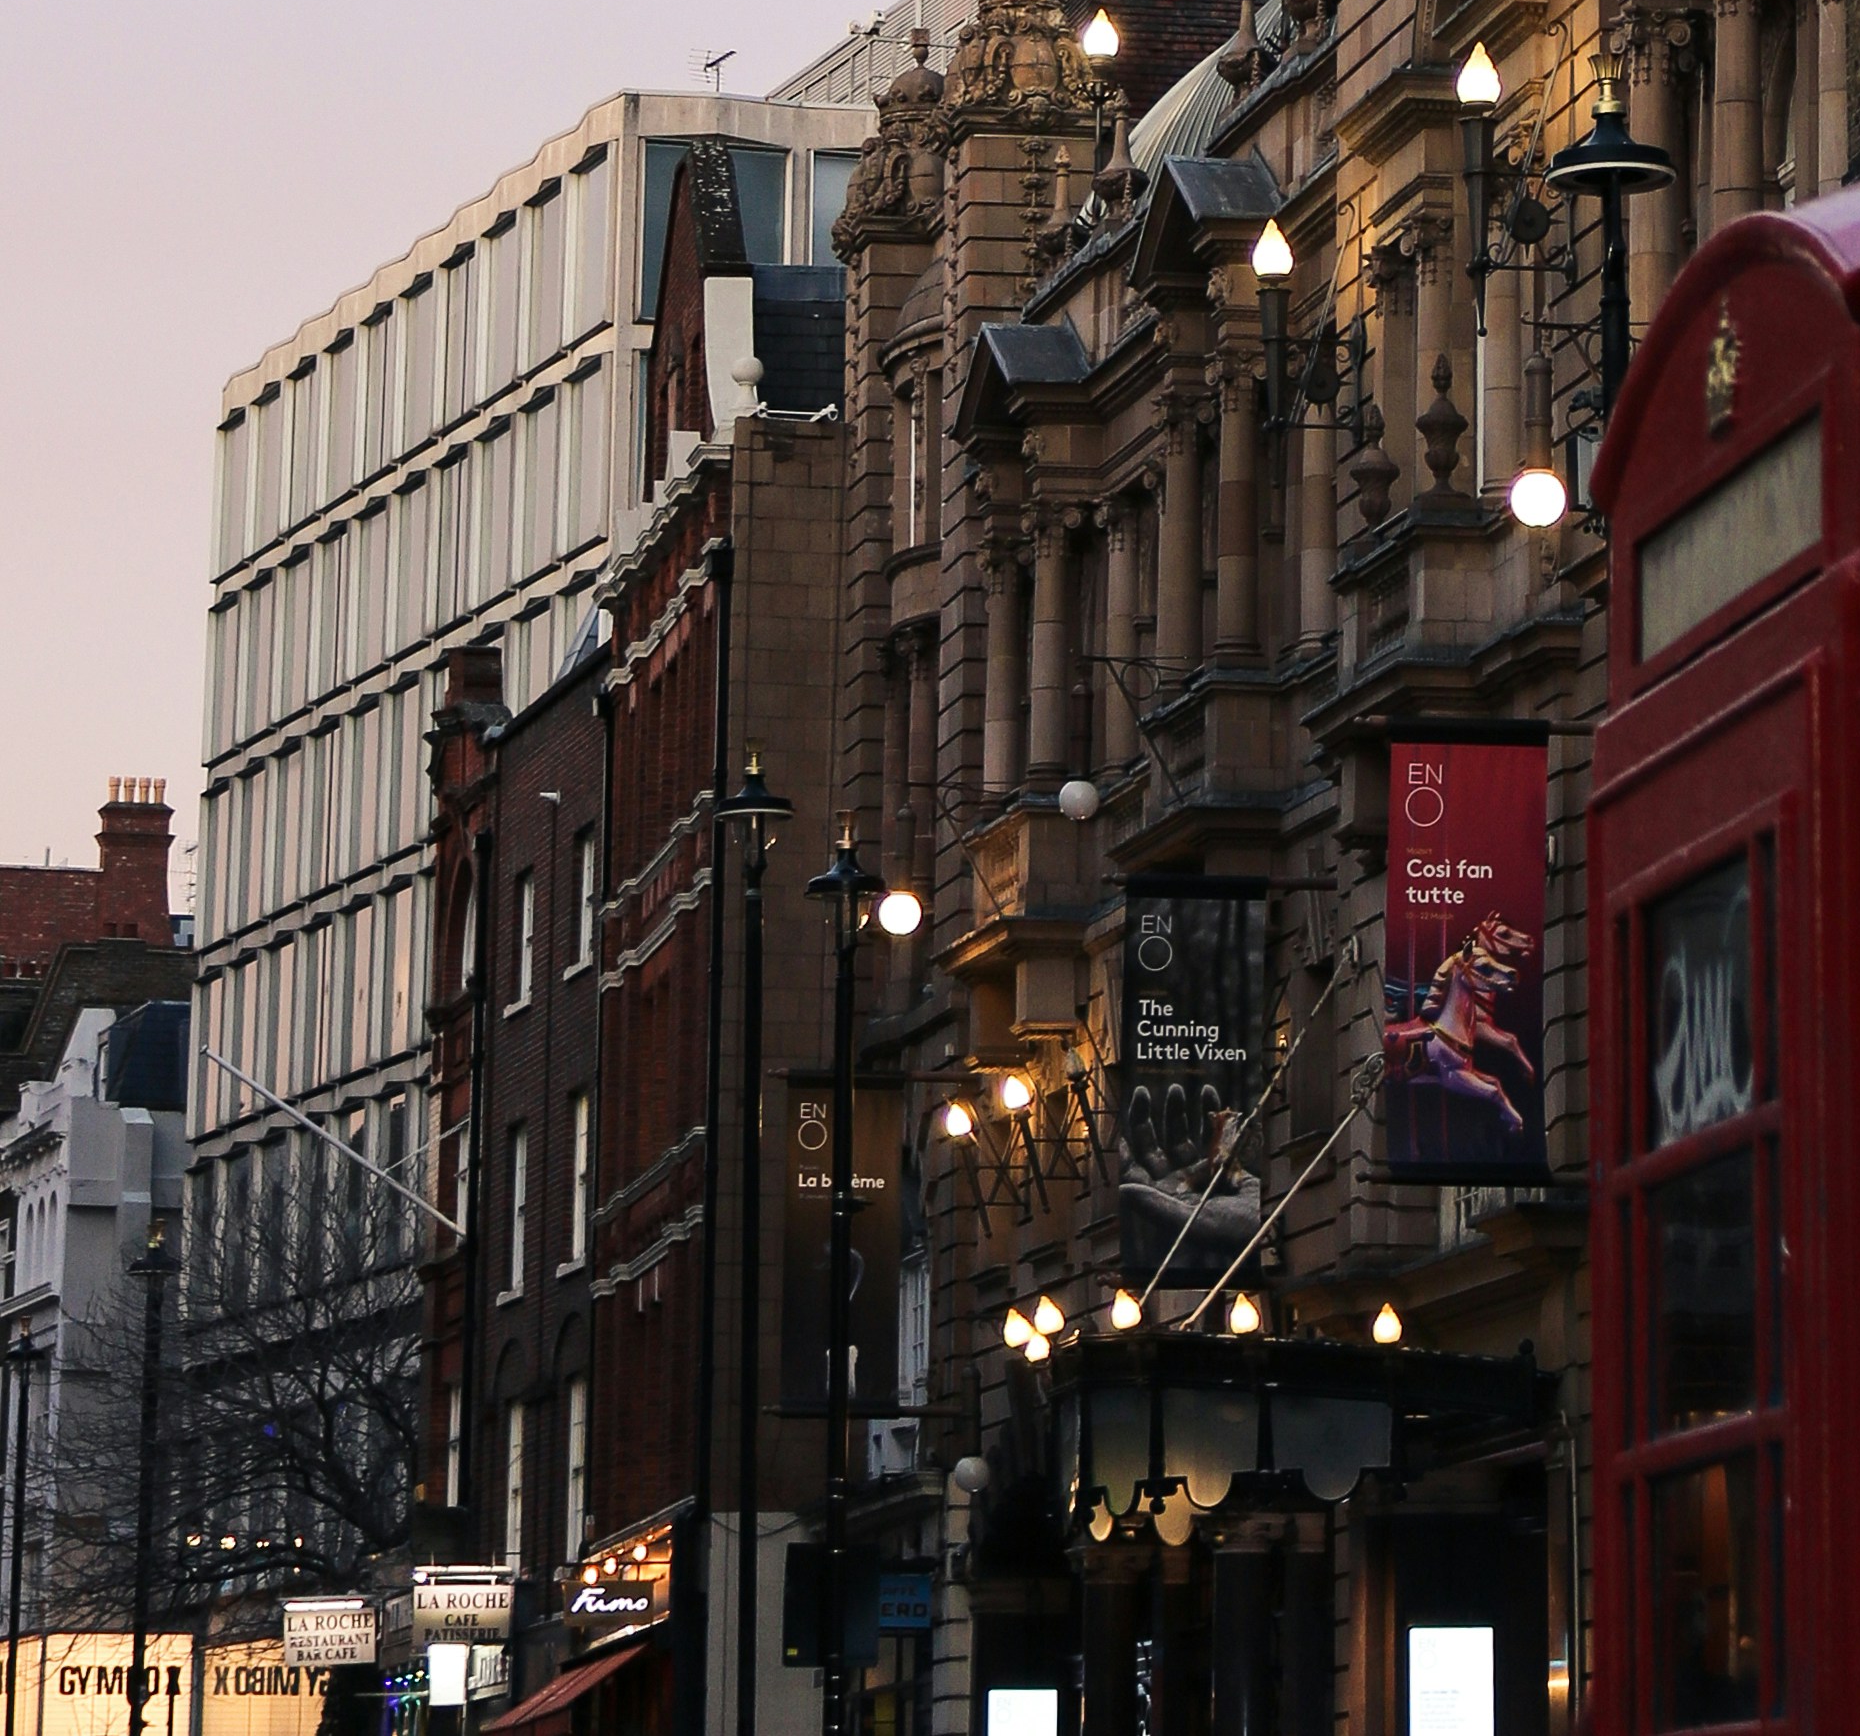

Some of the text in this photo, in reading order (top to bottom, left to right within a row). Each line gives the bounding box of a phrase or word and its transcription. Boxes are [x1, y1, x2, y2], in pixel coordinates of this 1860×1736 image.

[1408, 763, 1443, 785] EN
[1406, 858, 1493, 879] Così fan
[1405, 886, 1465, 904] tutte
[1141, 915, 1172, 934] EN
[1139, 999, 1174, 1016] The
[1137, 1020, 1219, 1043] Cunning
[1137, 1042, 1247, 1061] Little Vixen
[800, 1103, 826, 1119] EN
[798, 1173, 885, 1189] La bème
[417, 1592, 509, 1609] LA ROCHE
[571, 1587, 649, 1613] Fumo
[880, 1602, 928, 1617] ERO
[287, 1613, 374, 1632] LA ROCHE
[444, 1613, 479, 1626] CAFE
[290, 1633, 370, 1648] RESTAURANT
[424, 1628, 499, 1641] PATISSERIE
[296, 1647, 357, 1662] BAR CAFE
[60, 1665, 181, 1695] GYMOX
